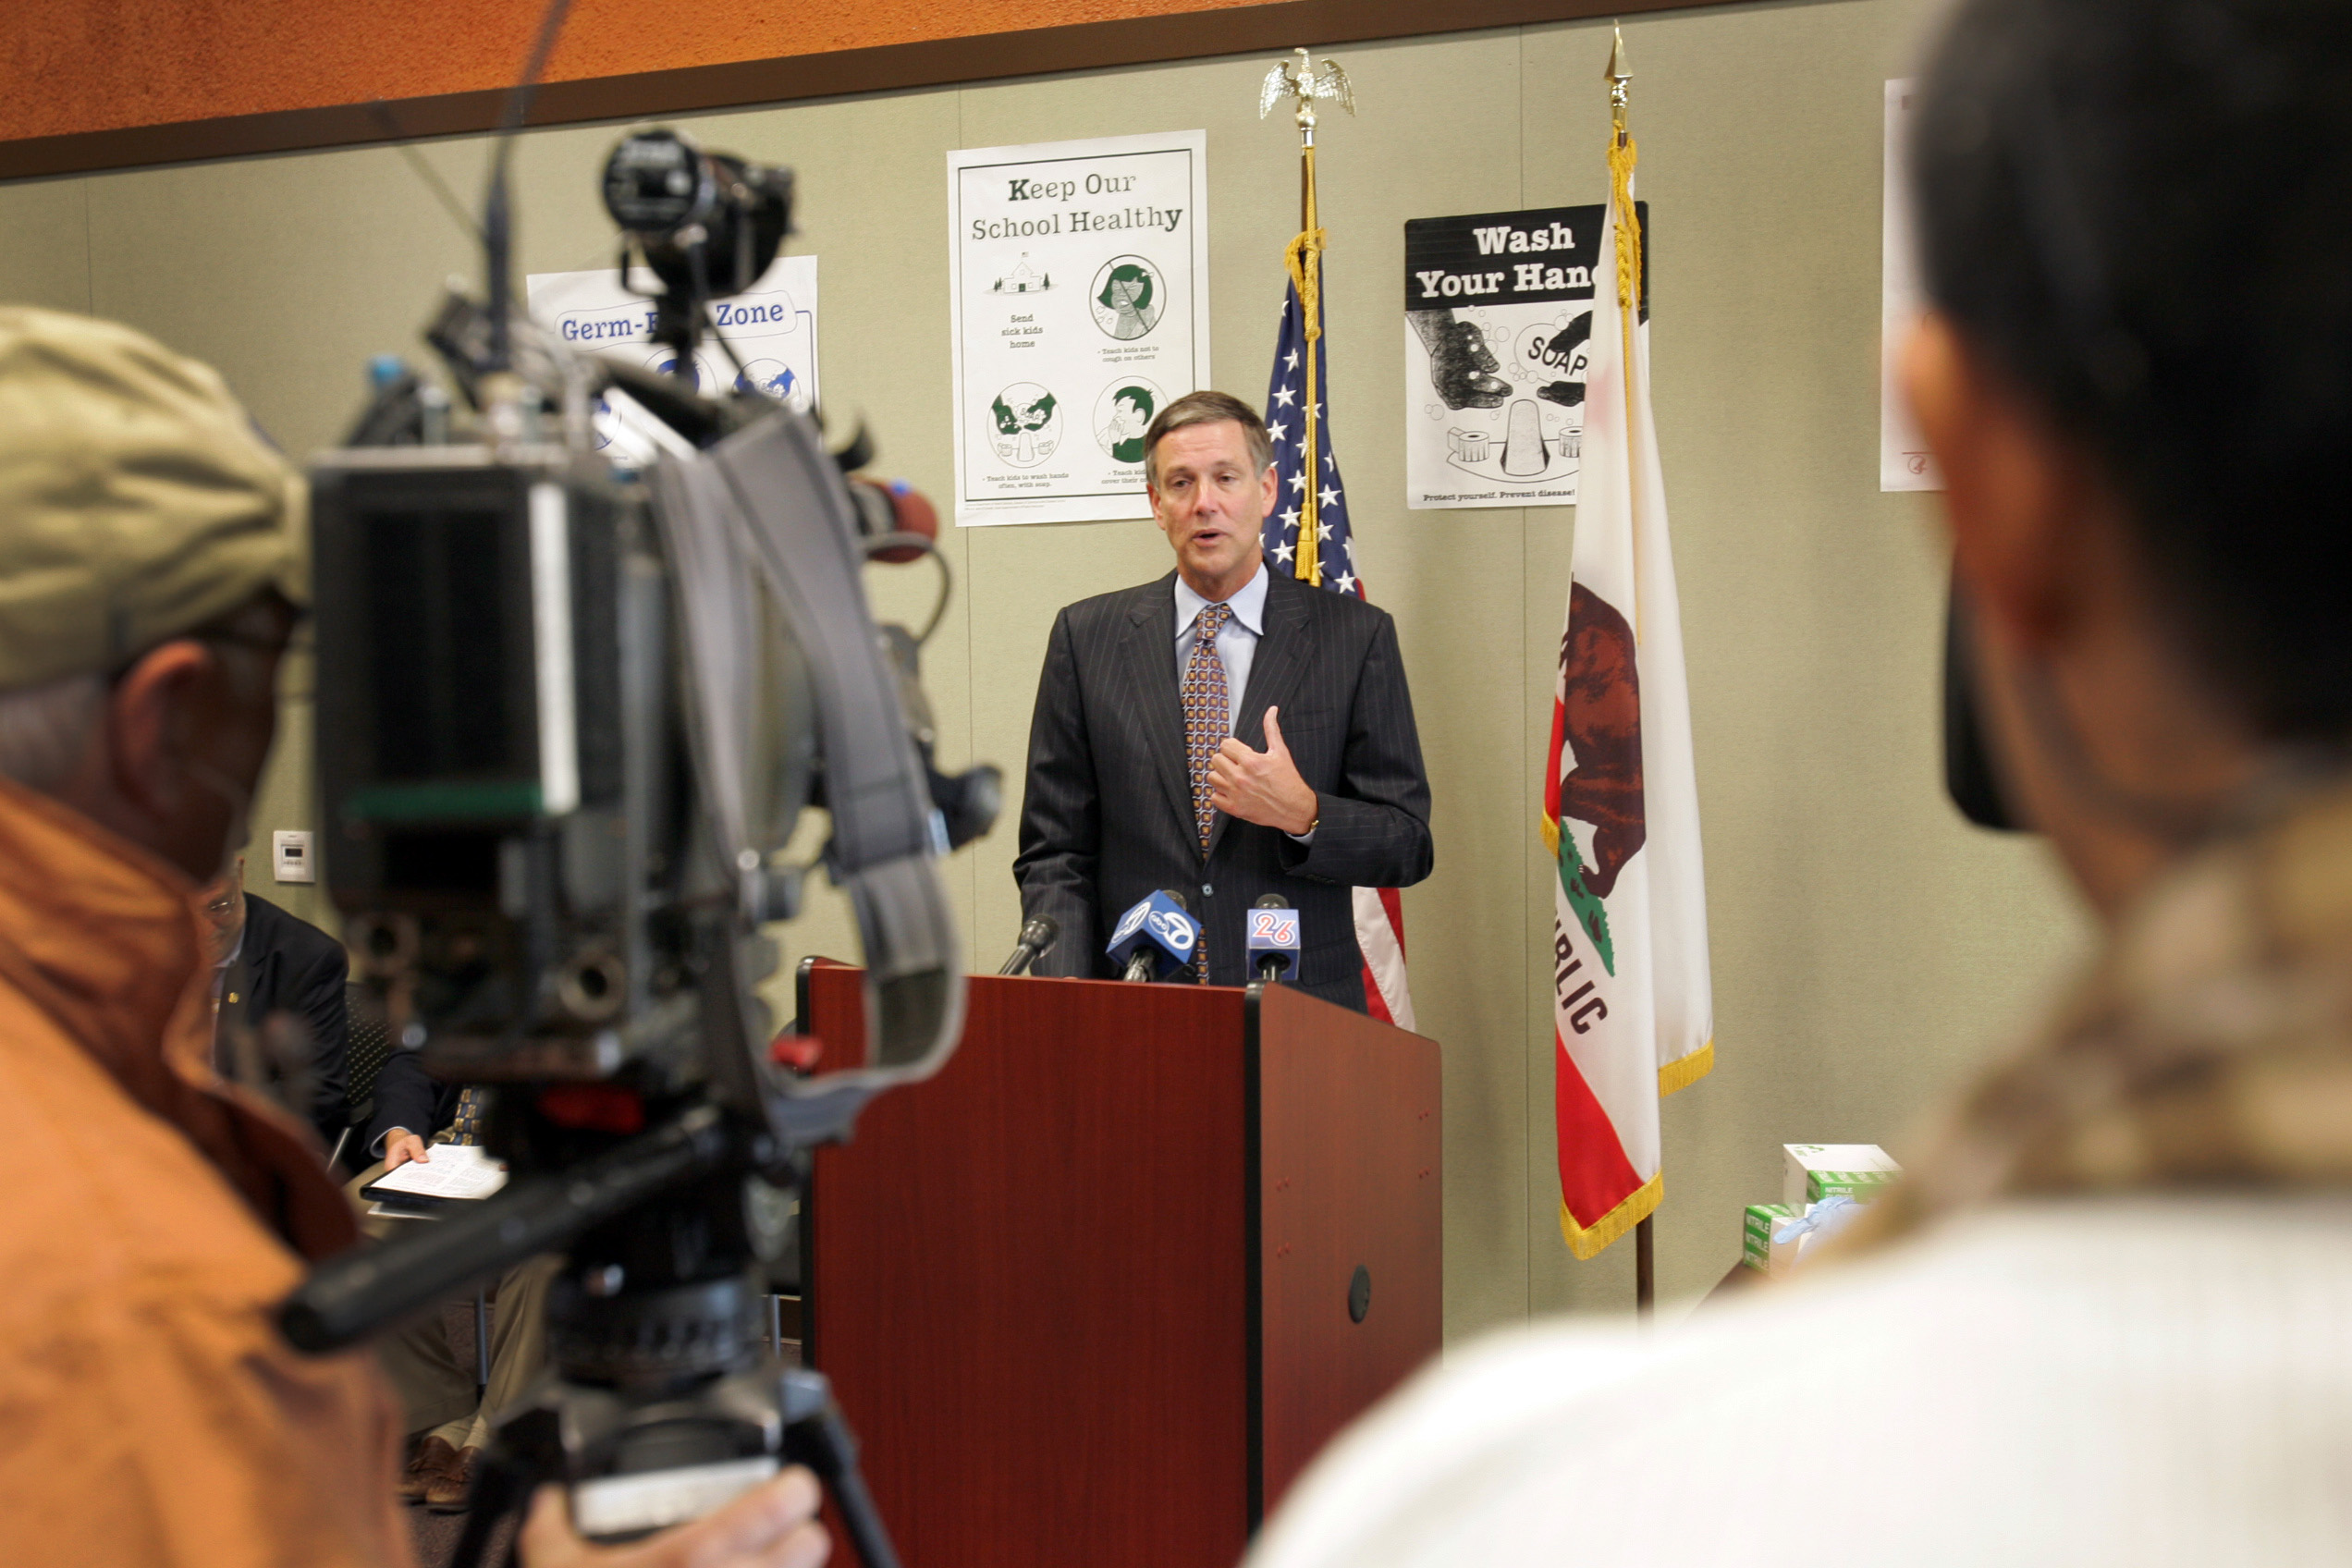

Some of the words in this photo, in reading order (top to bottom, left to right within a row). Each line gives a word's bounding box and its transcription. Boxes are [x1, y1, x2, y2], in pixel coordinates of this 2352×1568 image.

[1008, 178, 1075, 202] Keep
[1085, 174, 1136, 194] Our
[972, 214, 1060, 240] School
[1069, 206, 1182, 232] Healthy
[1473, 222, 1575, 255] Wash
[1415, 270, 1505, 298] Your
[1513, 263, 1599, 291] Han
[562, 312, 659, 341] Germ-F
[716, 304, 784, 326] Zone
[1001, 327, 1021, 336] sick
[1023, 326, 1043, 335] kids
[1011, 314, 1034, 323] Send
[1010, 340, 1035, 349] home
[1528, 337, 1588, 376] SOAP
[1458, 491, 1497, 502] yourself.
[1500, 490, 1536, 499] Prevent
[1537, 489, 1575, 497] disease!
[1252, 912, 1296, 947] 26
[1555, 919, 1609, 1035] BLIC
